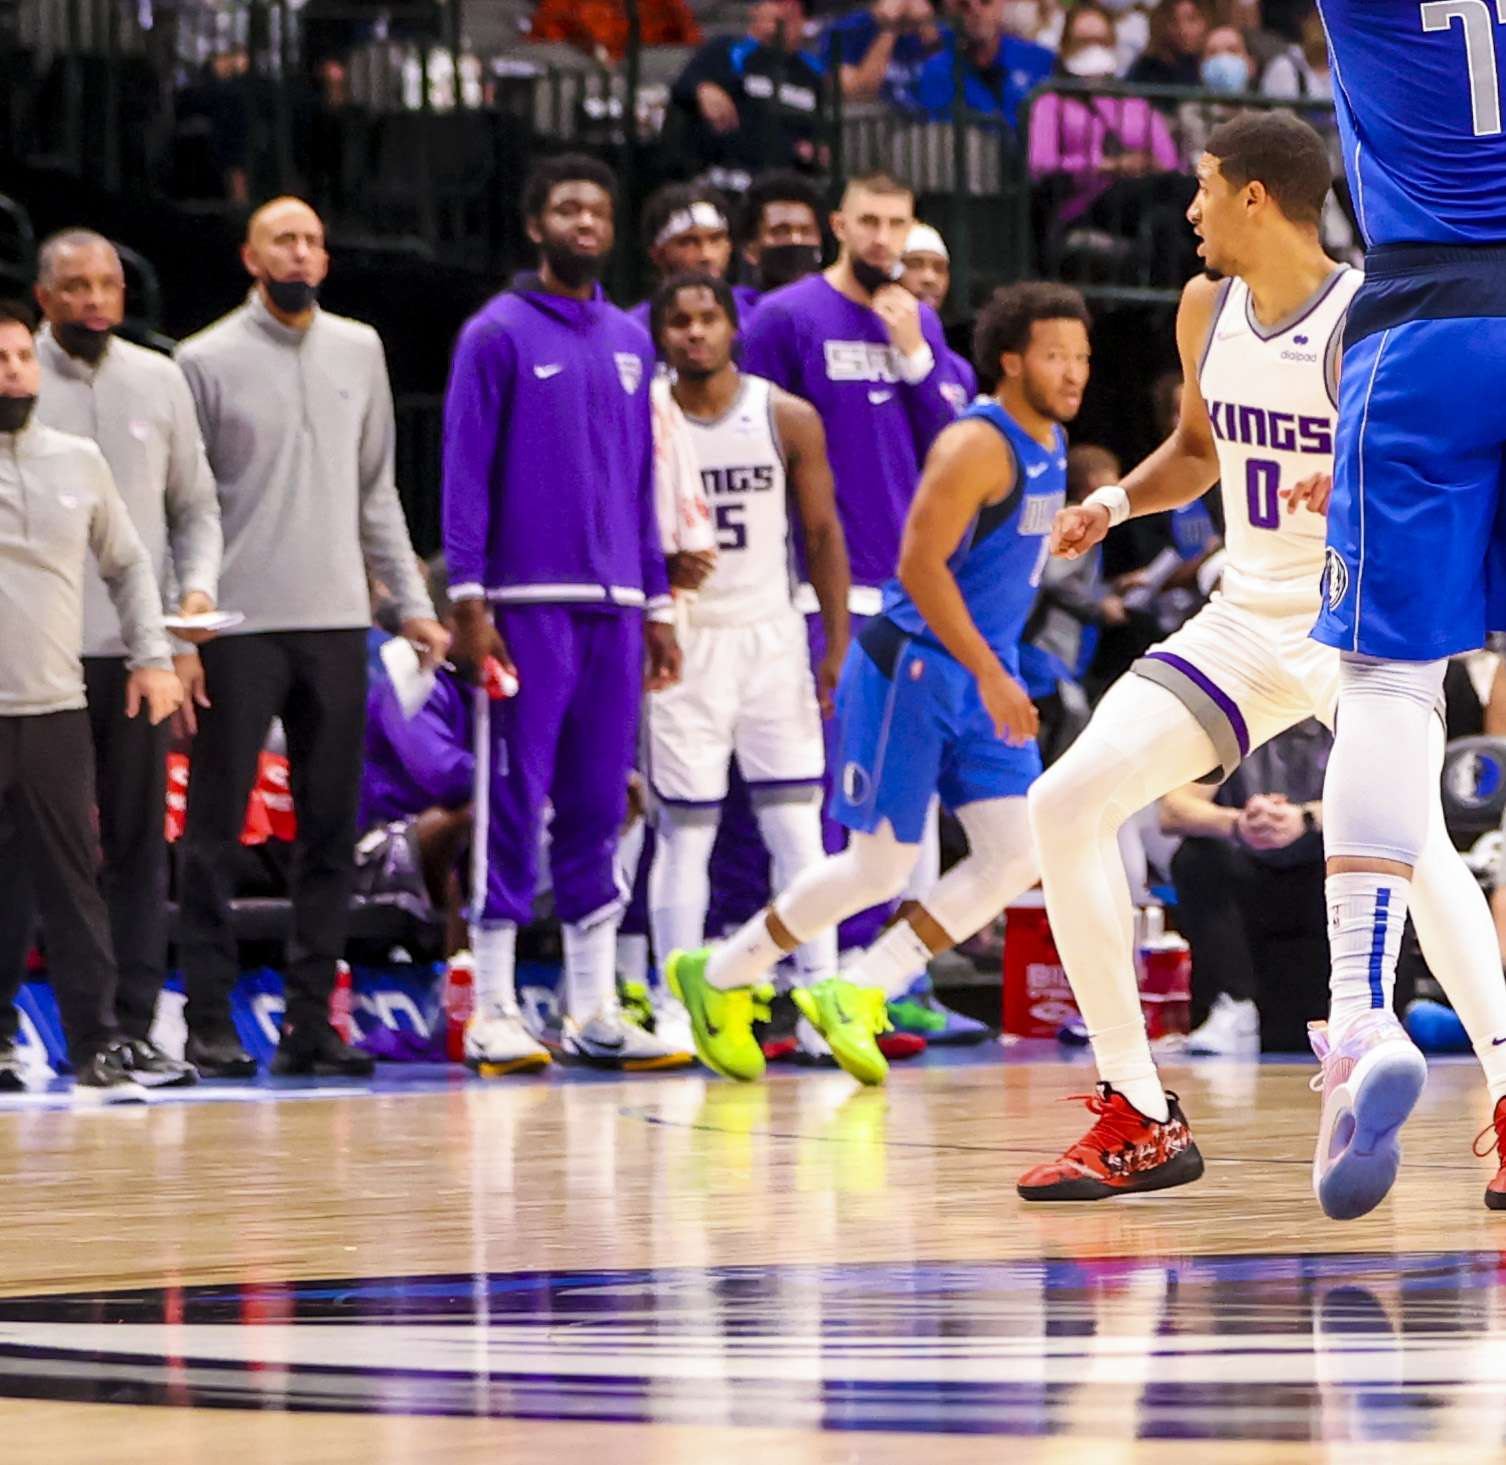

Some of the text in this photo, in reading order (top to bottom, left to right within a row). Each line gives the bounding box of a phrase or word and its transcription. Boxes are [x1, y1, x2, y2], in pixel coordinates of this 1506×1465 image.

[1281, 350, 1317, 363] dialpad
[1204, 398, 1332, 454] KINGS
[700, 465, 774, 497] NGS
[1246, 458, 1281, 530] 0
